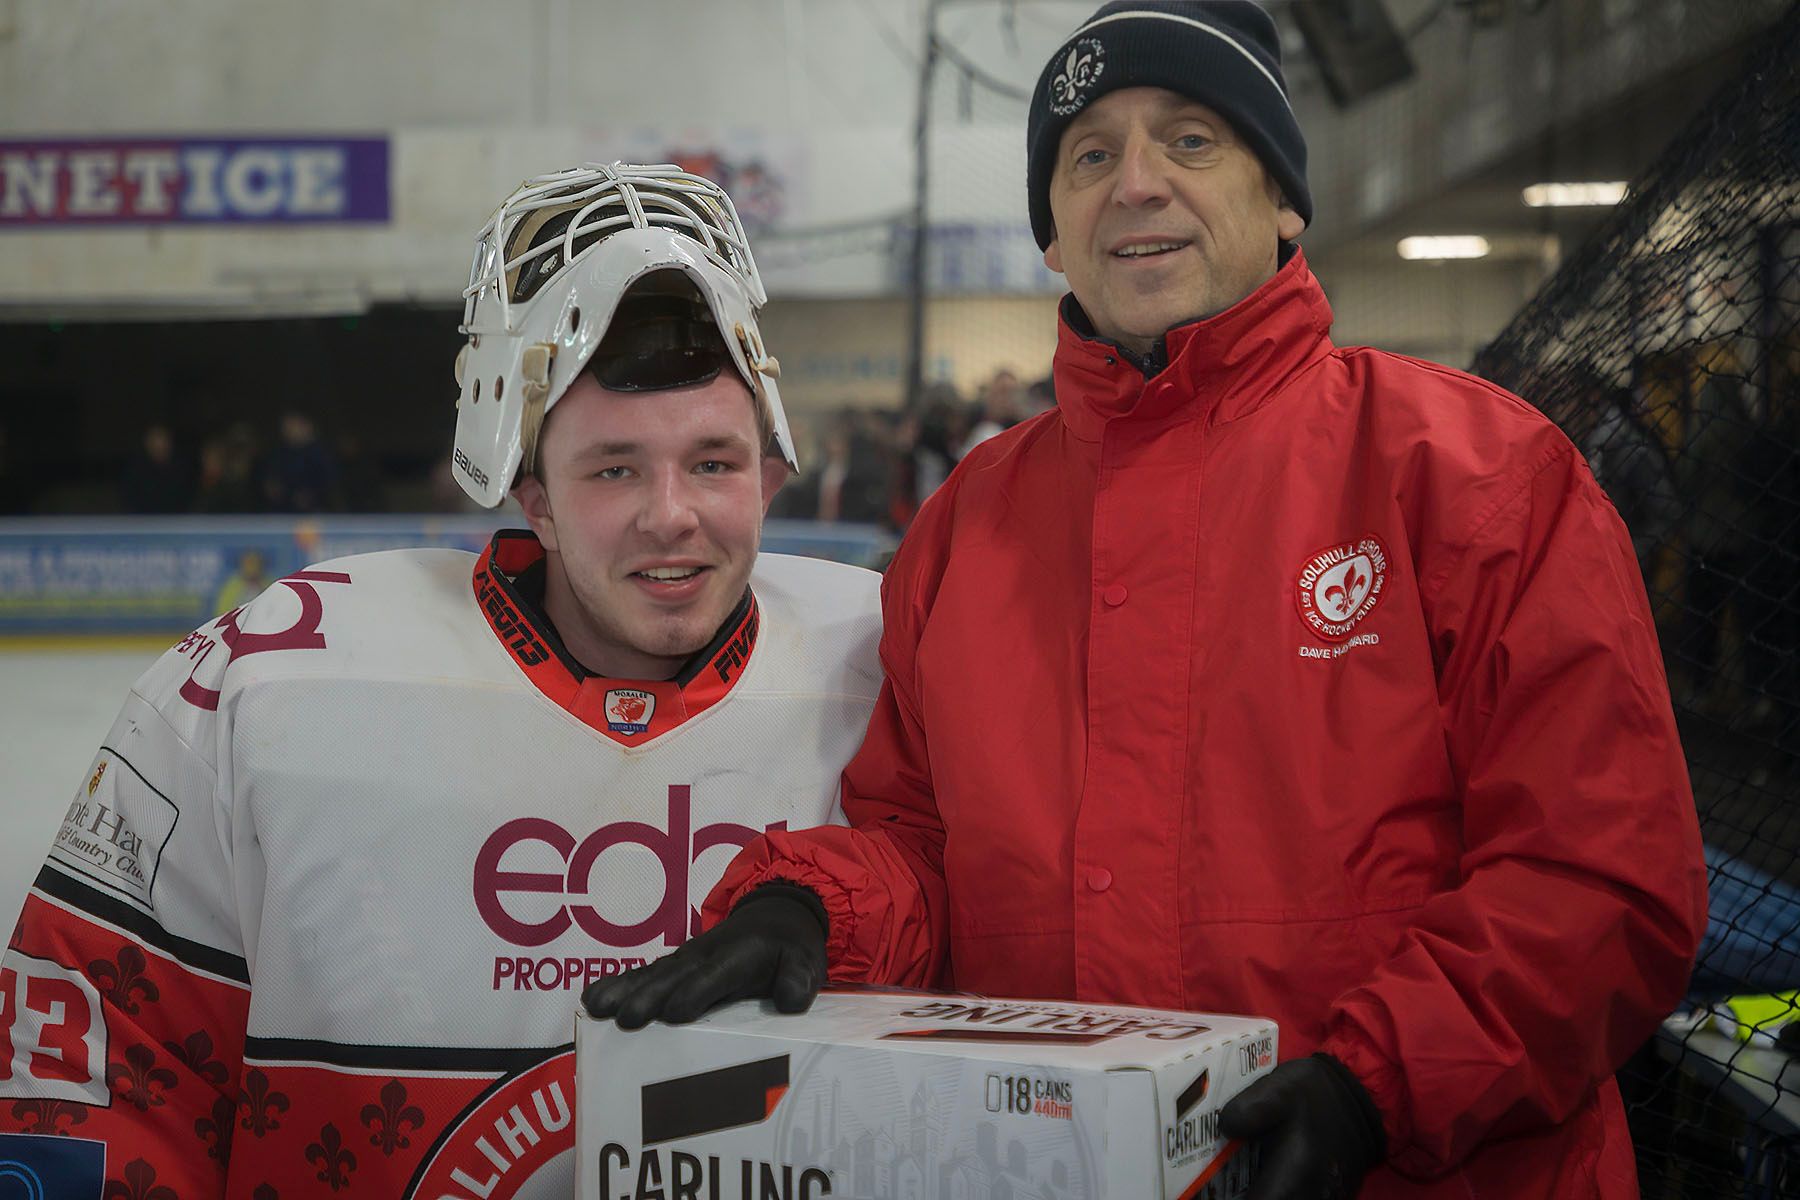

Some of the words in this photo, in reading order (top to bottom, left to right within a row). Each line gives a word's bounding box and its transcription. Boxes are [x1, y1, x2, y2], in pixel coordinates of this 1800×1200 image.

[1299, 545, 1357, 590] SOLIHULL
[1299, 646, 1332, 659] DAVE
[898, 1002, 1212, 1040] CARLING
[1004, 1076, 1031, 1115] 18
[1034, 1079, 1073, 1103] CANS
[1032, 1099, 1073, 1120] 440ml
